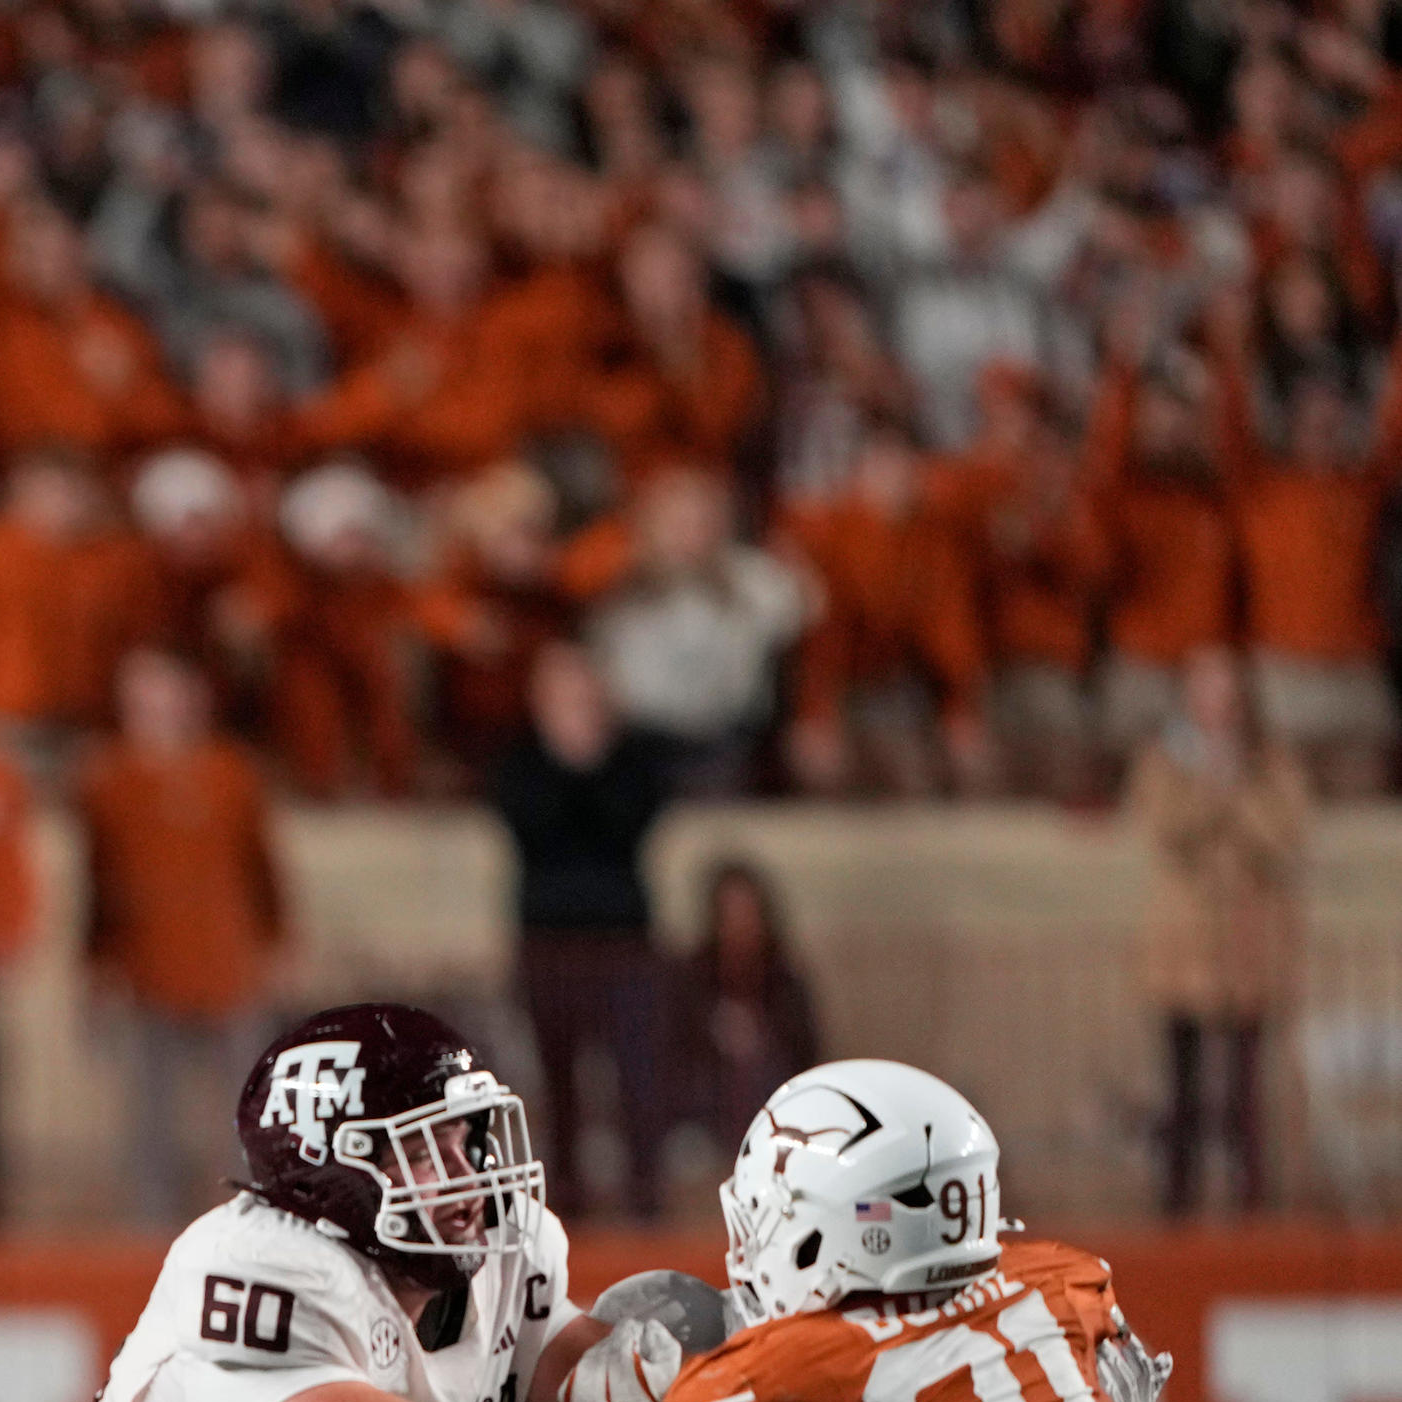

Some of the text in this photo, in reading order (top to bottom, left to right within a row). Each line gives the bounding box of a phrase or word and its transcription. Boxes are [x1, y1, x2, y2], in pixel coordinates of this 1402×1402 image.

[939, 1173, 986, 1245] 91
[200, 1274, 296, 1354] 60
[524, 1273, 551, 1322] C
